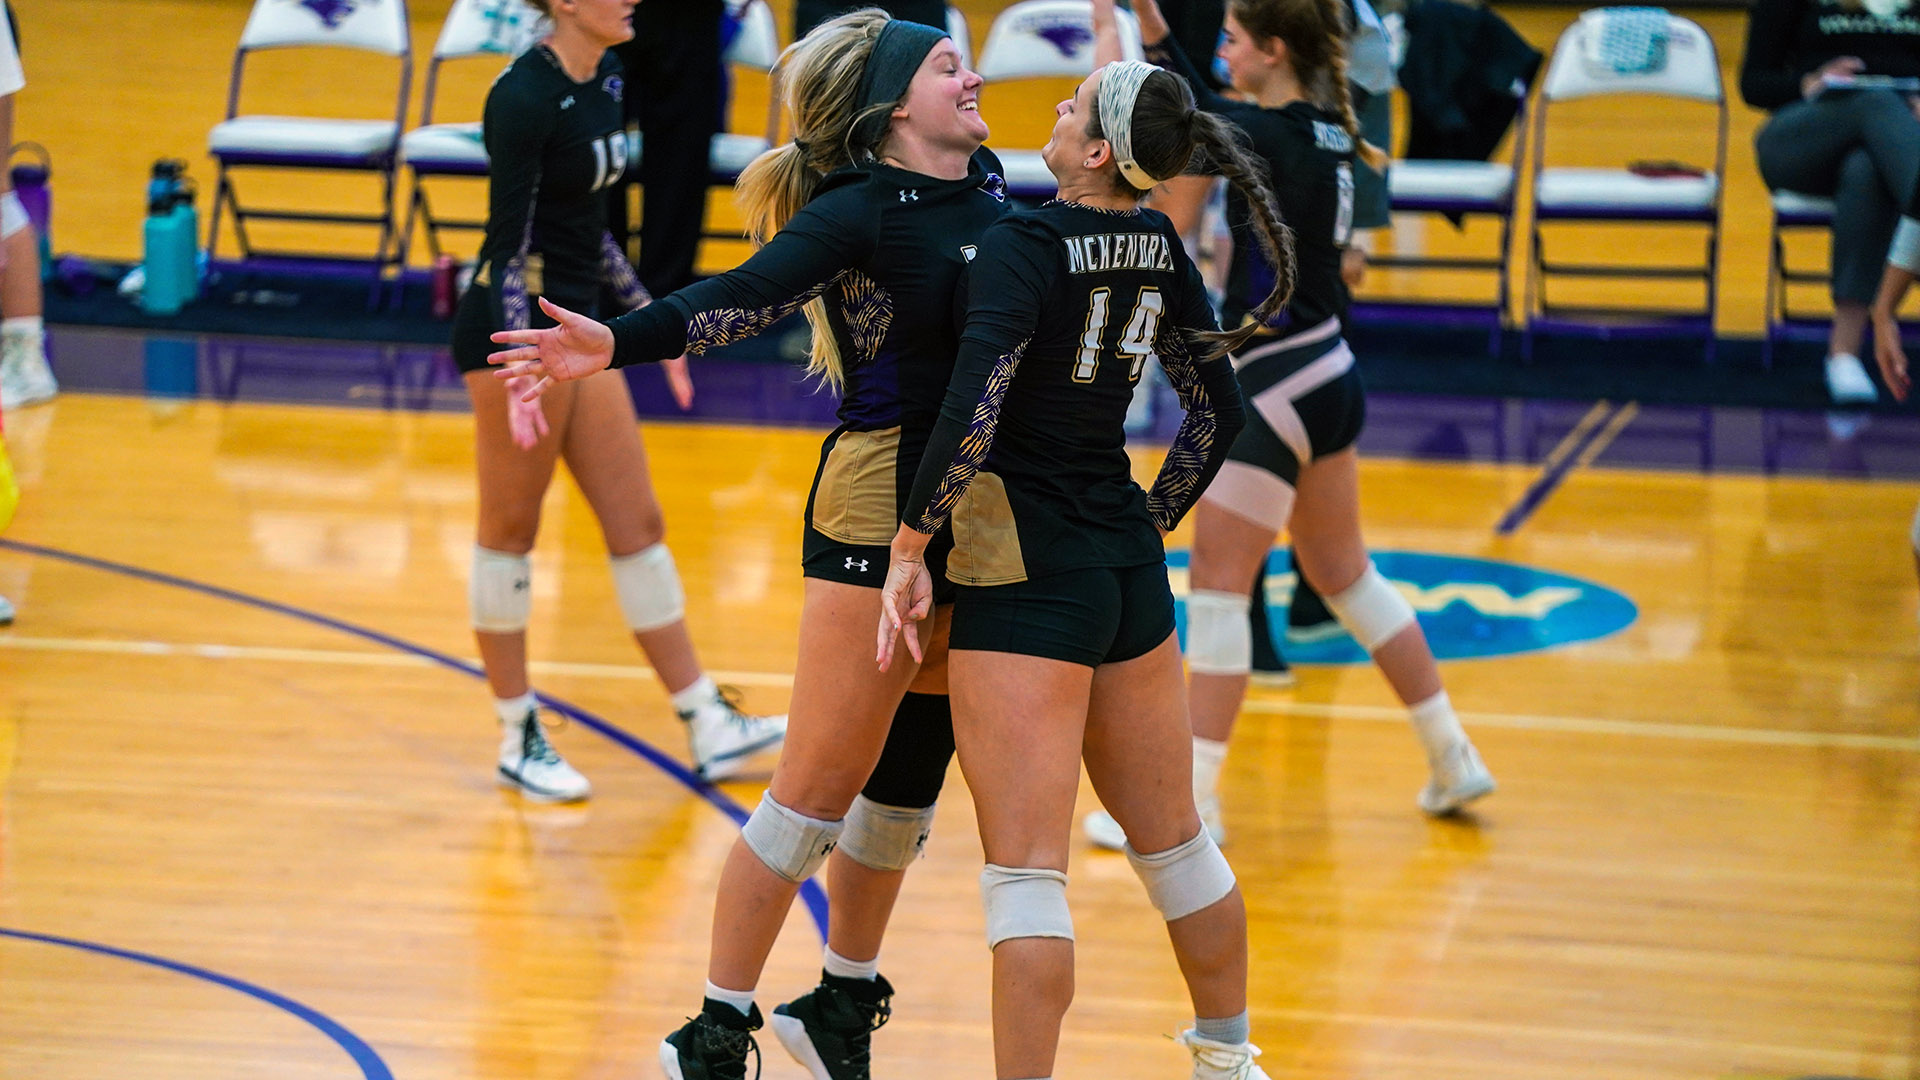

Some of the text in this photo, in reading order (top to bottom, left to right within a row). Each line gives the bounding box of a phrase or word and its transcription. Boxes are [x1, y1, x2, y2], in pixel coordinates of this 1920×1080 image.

[590, 130, 628, 193] 19
[1063, 233, 1175, 273] MCKENDRE
[1071, 286, 1165, 384] 14
